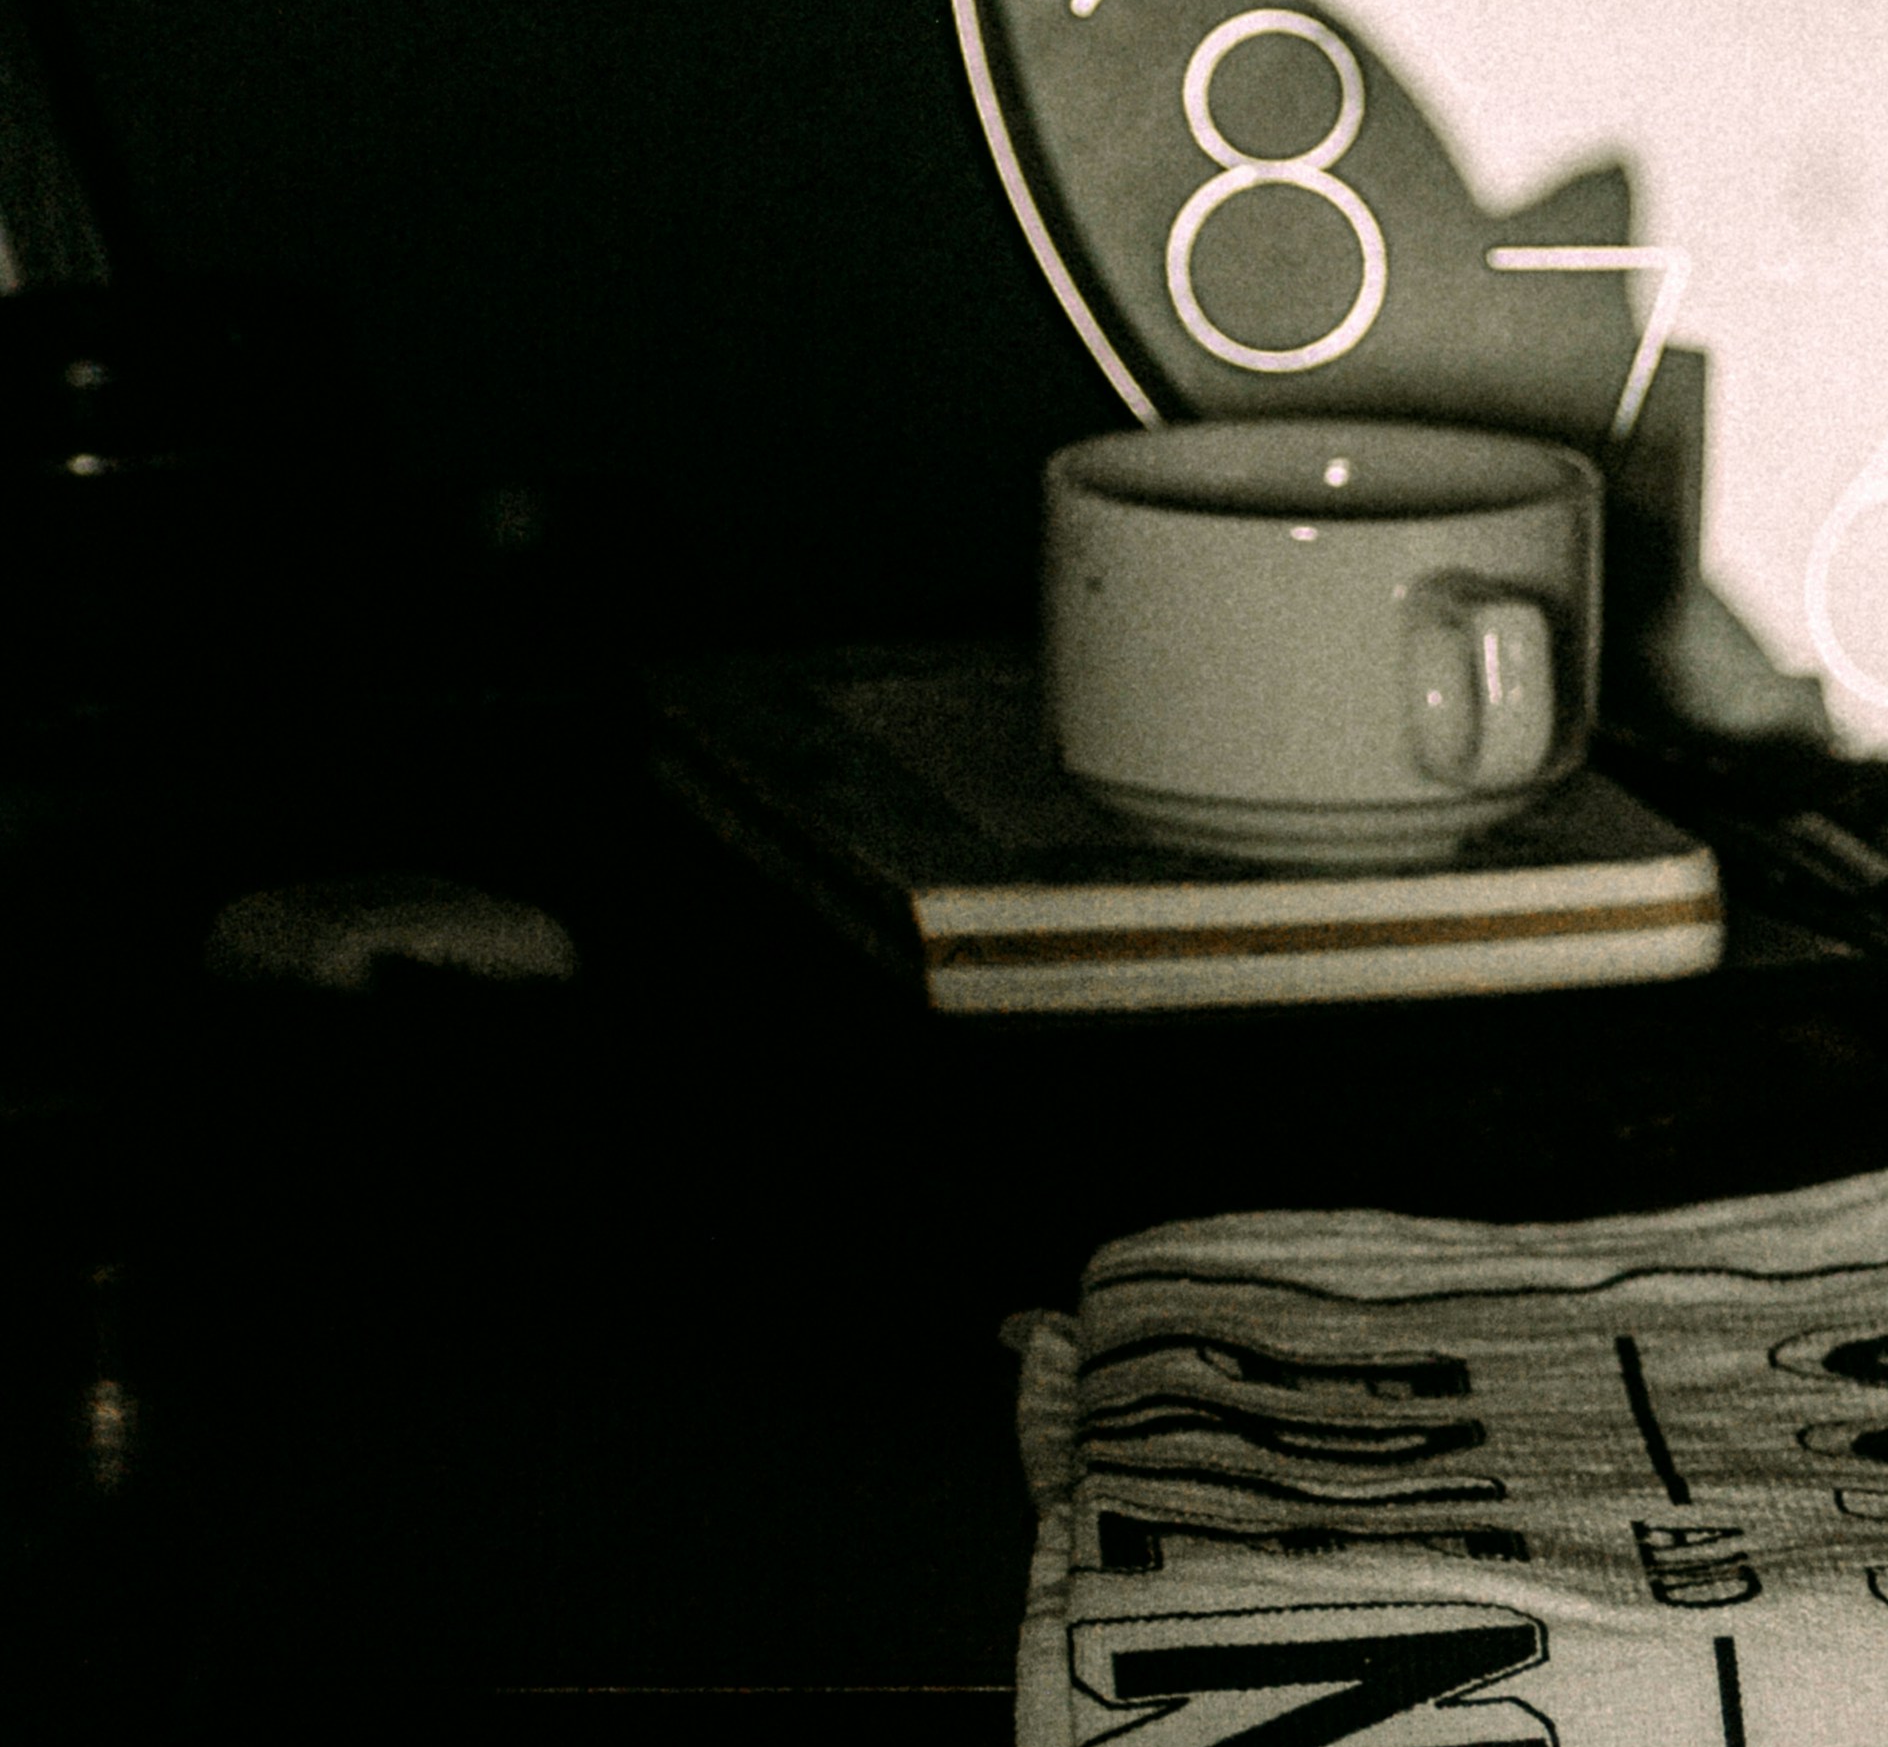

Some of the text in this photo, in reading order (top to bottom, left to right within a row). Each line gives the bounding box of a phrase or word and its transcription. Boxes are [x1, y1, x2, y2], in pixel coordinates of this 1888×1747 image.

[1165, 7, 1387, 373] 8
[1486, 245, 1690, 442] 7
[1633, 1519, 1762, 1608] AND
